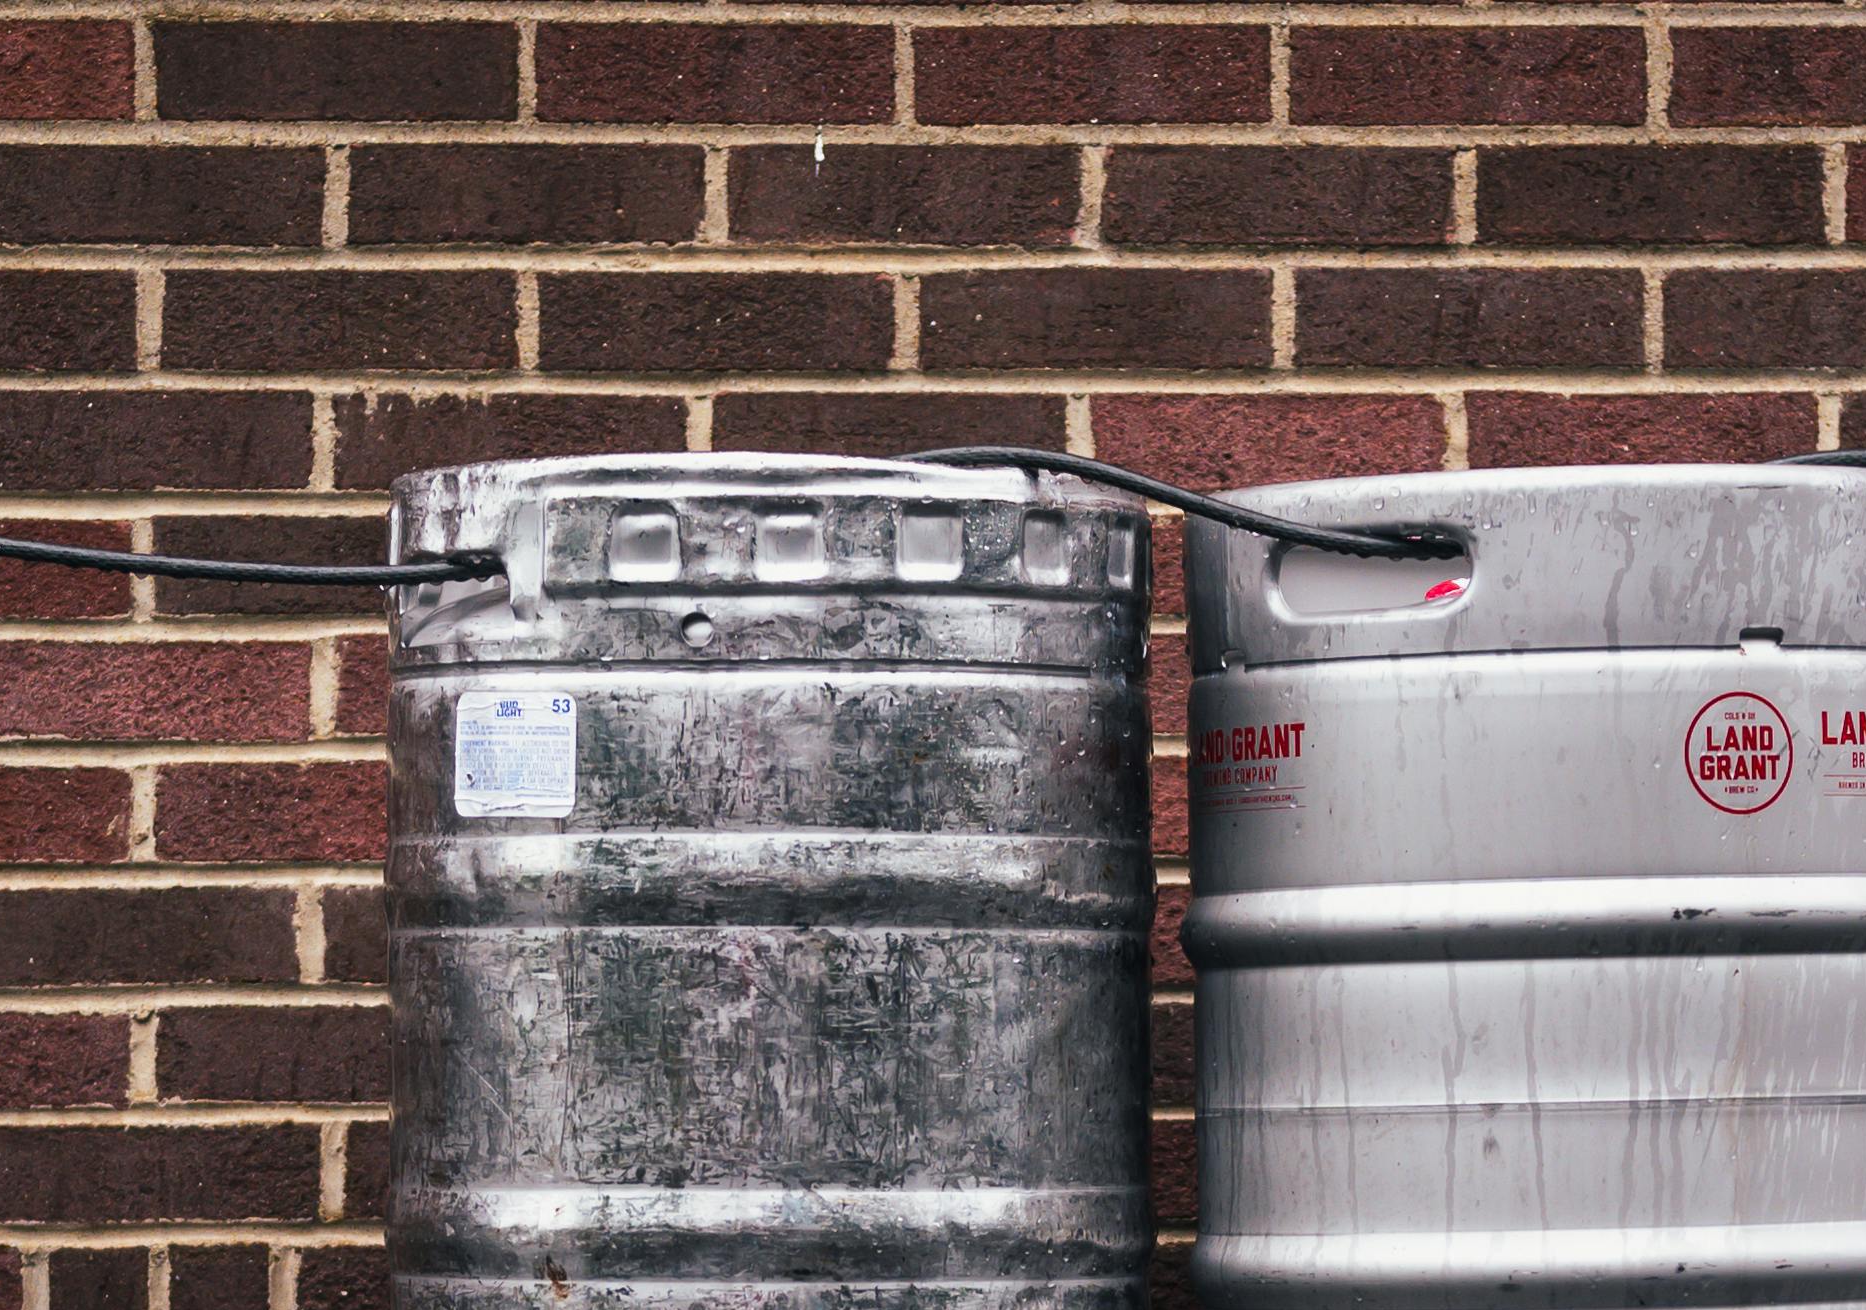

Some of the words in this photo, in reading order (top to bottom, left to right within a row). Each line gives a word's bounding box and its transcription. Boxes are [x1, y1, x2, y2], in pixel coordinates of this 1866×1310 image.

[552, 698, 571, 713] 53
[1231, 722, 1305, 763] GRANT
[1705, 726, 1774, 752] LAND
[1235, 764, 1278, 785] COMPANY
[1699, 755, 1781, 781] GRANT
